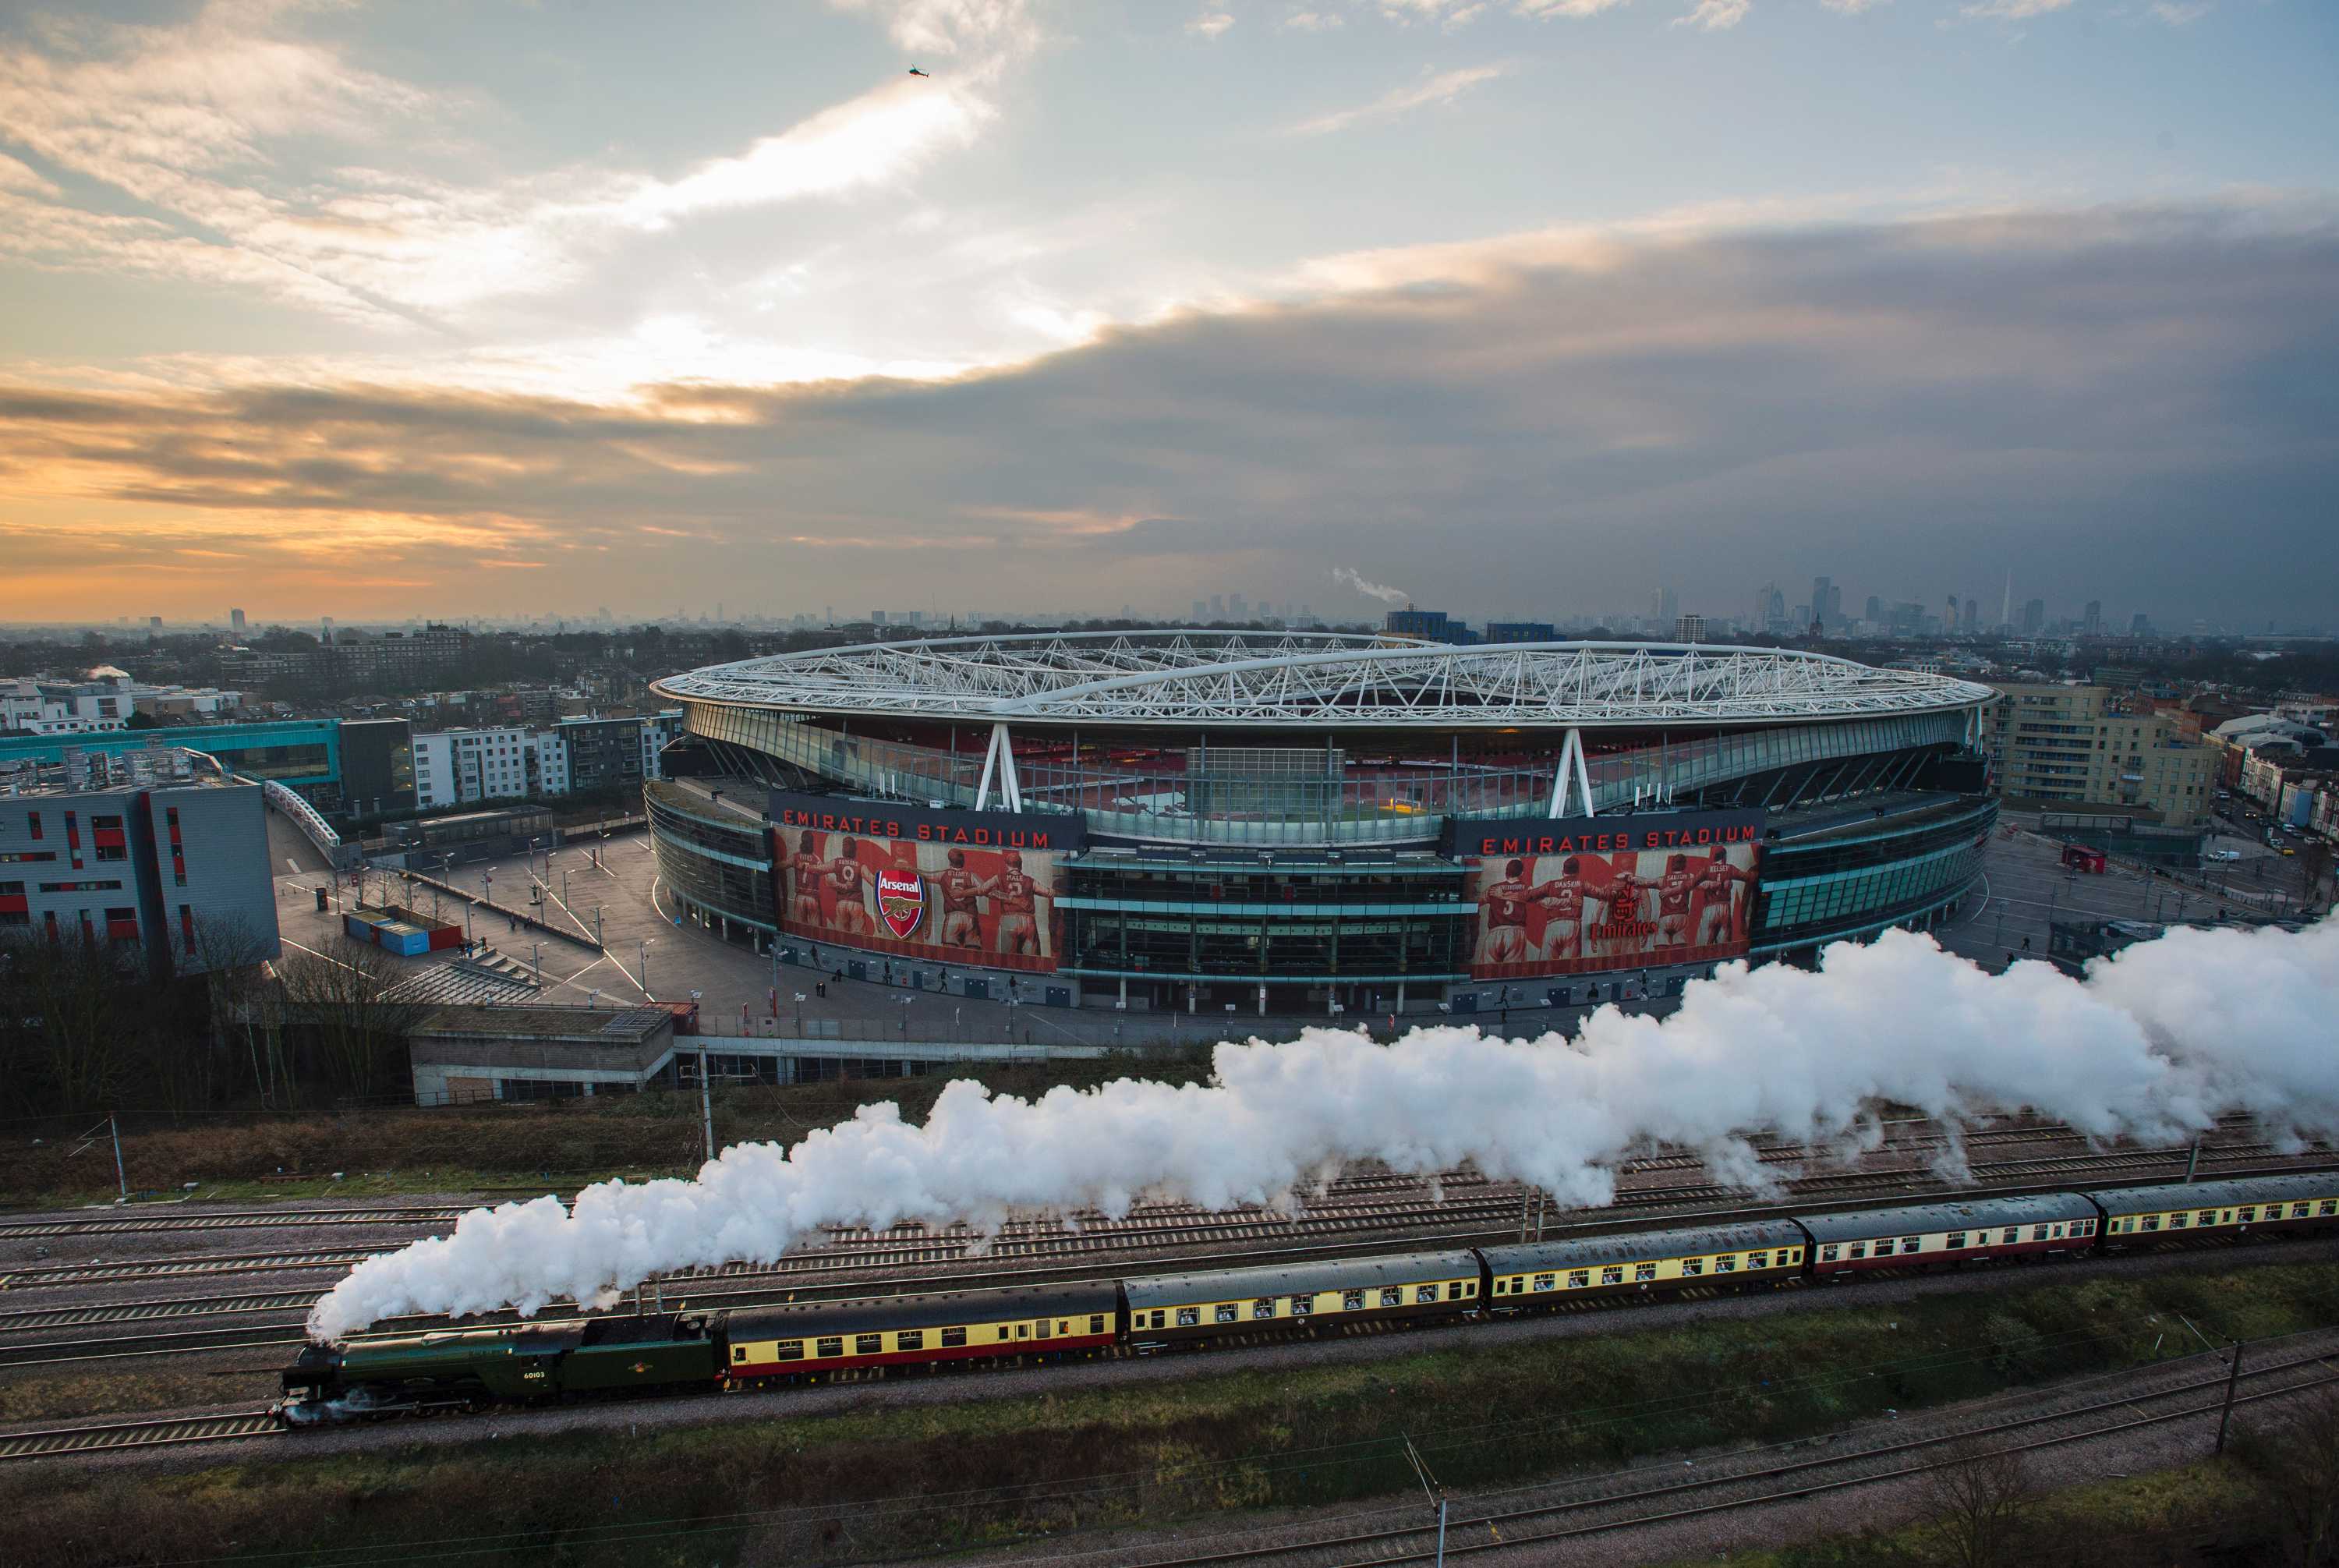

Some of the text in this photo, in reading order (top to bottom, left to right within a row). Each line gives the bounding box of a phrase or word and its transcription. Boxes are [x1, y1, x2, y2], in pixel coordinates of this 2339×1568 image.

[784, 809, 1048, 848] EMIRATES STADIUM
[1483, 826, 1755, 855] EMIRATES STADIUM
[880, 877, 918, 894] Arsenal
[1555, 880, 1581, 890] DANSKIN
[1591, 922, 1658, 940] Emirates
